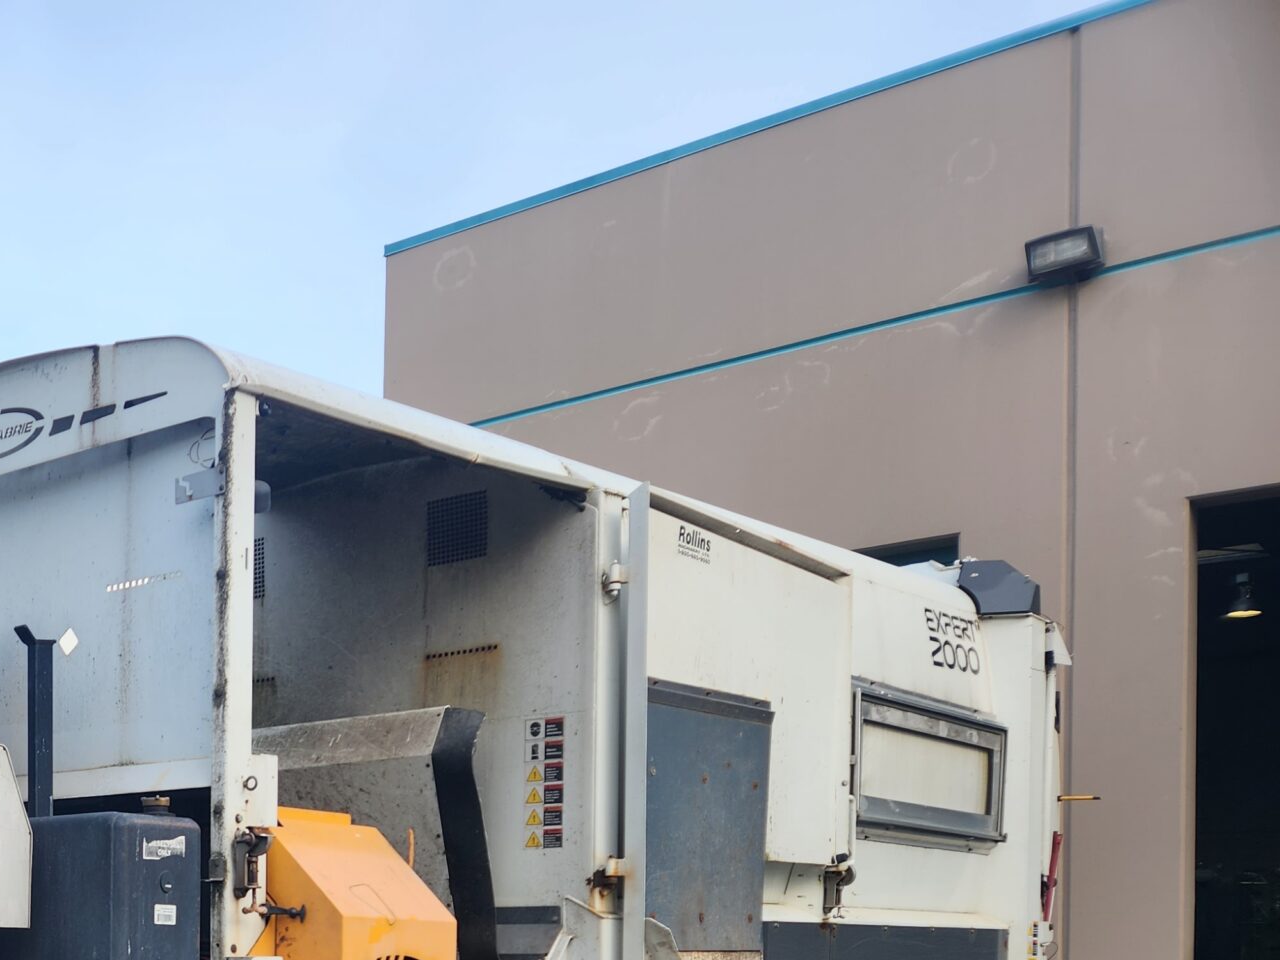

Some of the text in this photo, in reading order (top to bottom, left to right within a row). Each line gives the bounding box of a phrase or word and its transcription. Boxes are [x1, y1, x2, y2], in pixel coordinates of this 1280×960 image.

[678, 525, 711, 552] Rollins
[924, 607, 976, 642] EXPERT
[929, 636, 980, 675] 2000
